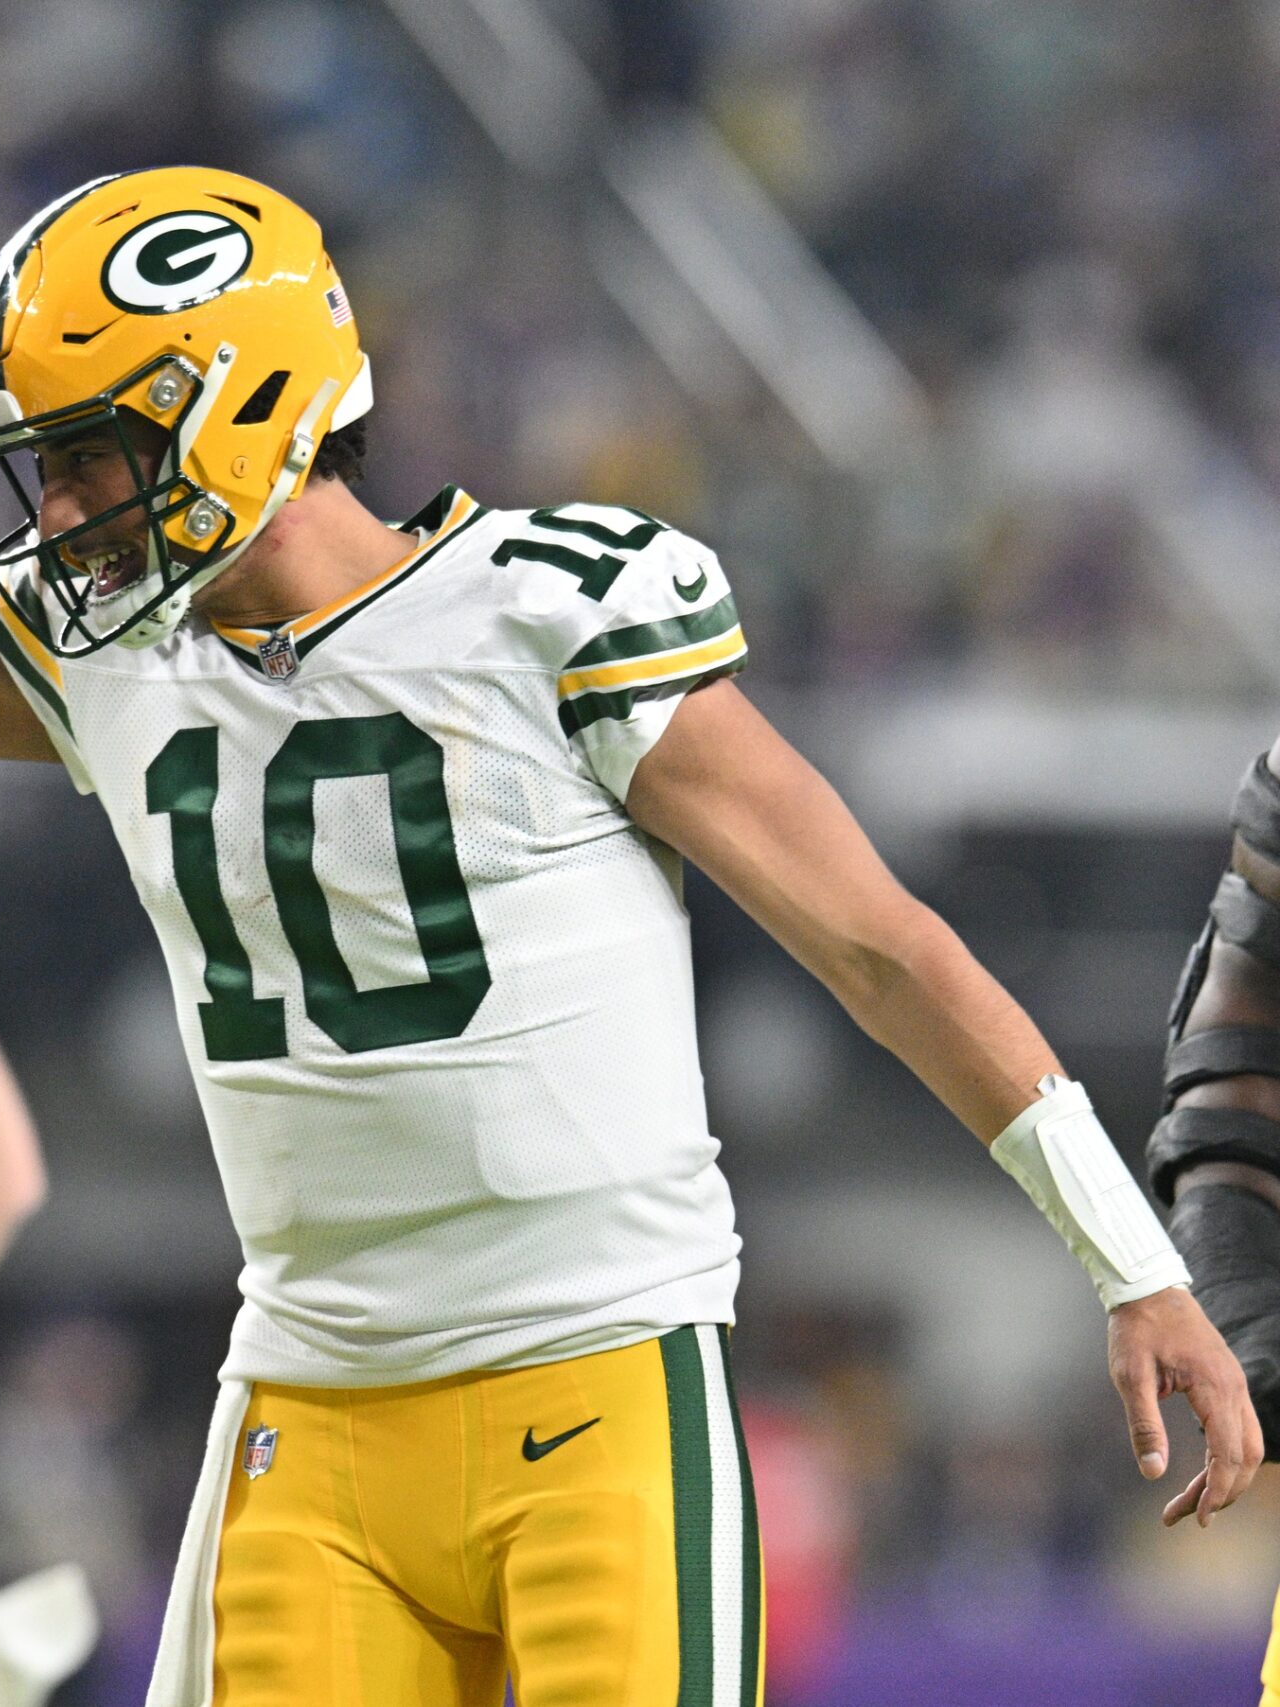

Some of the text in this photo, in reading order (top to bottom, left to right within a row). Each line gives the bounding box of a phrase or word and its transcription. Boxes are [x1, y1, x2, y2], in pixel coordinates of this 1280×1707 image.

[108, 214, 248, 307] G
[490, 502, 671, 602] 10
[266, 652, 294, 677] NFL
[146, 711, 492, 1061] 10
